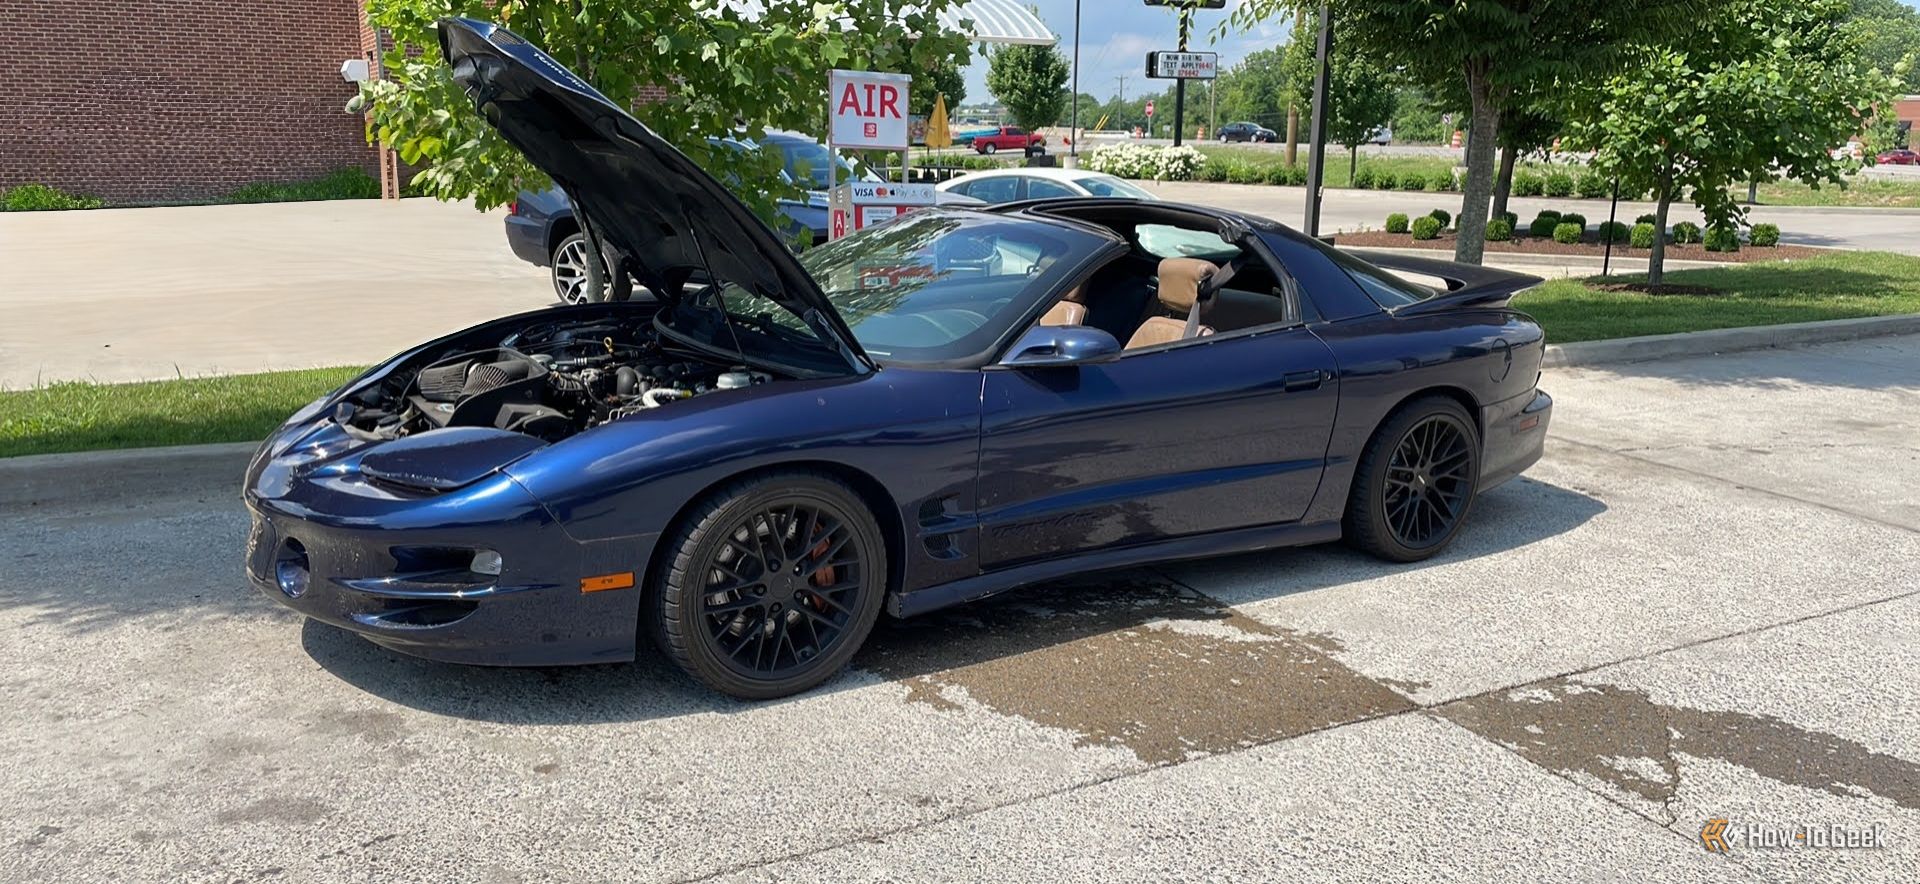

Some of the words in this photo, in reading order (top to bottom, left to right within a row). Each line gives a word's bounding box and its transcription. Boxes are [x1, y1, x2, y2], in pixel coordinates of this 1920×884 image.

[1181, 54, 1202, 62] HIRING
[1163, 61, 1177, 69] TEXT
[838, 82, 902, 119] AIR
[854, 187, 874, 197] VISA
